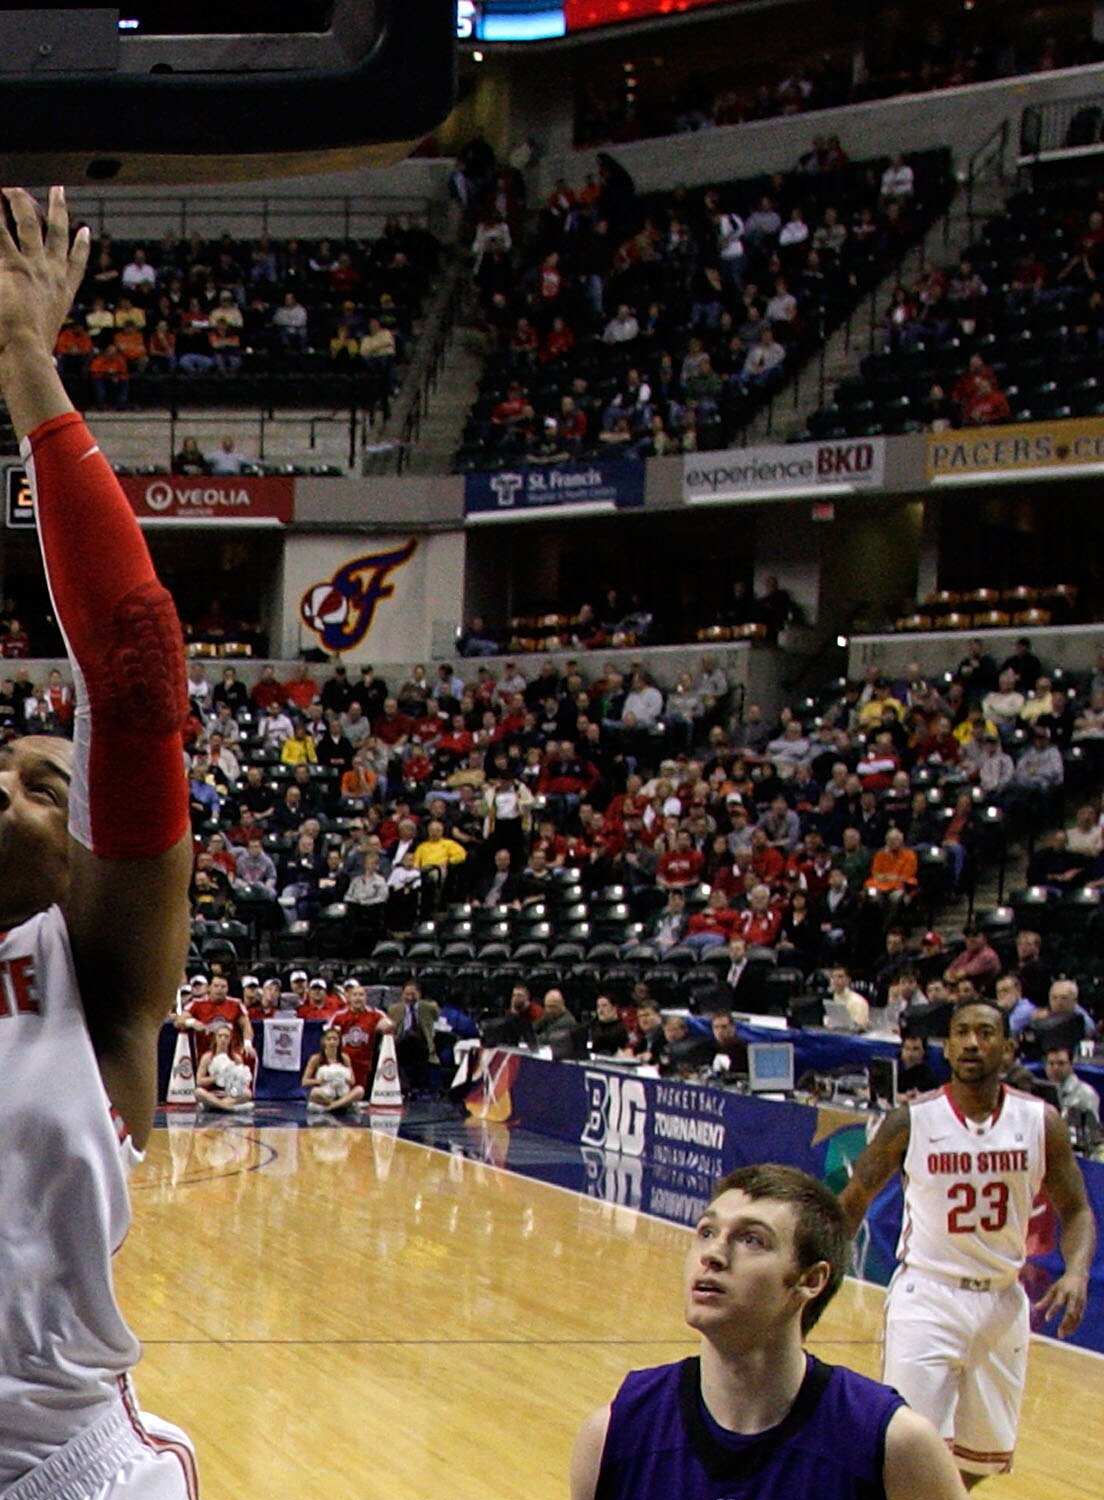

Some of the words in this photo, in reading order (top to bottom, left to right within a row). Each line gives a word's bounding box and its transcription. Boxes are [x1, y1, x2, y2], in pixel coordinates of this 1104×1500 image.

[686, 459, 813, 492] experience
[816, 443, 874, 475] BKD
[933, 437, 1052, 468] PACERS
[549, 467, 603, 489] Francis
[175, 488, 250, 506] VEOLIA
[580, 1071, 646, 1156] BIG
[655, 1085, 726, 1117] BASKETBALL
[654, 1111, 726, 1150] TOURNAMENT
[927, 1152, 971, 1175] OHIO
[977, 1150, 1029, 1173] STATE
[947, 1182, 1010, 1234] 23
